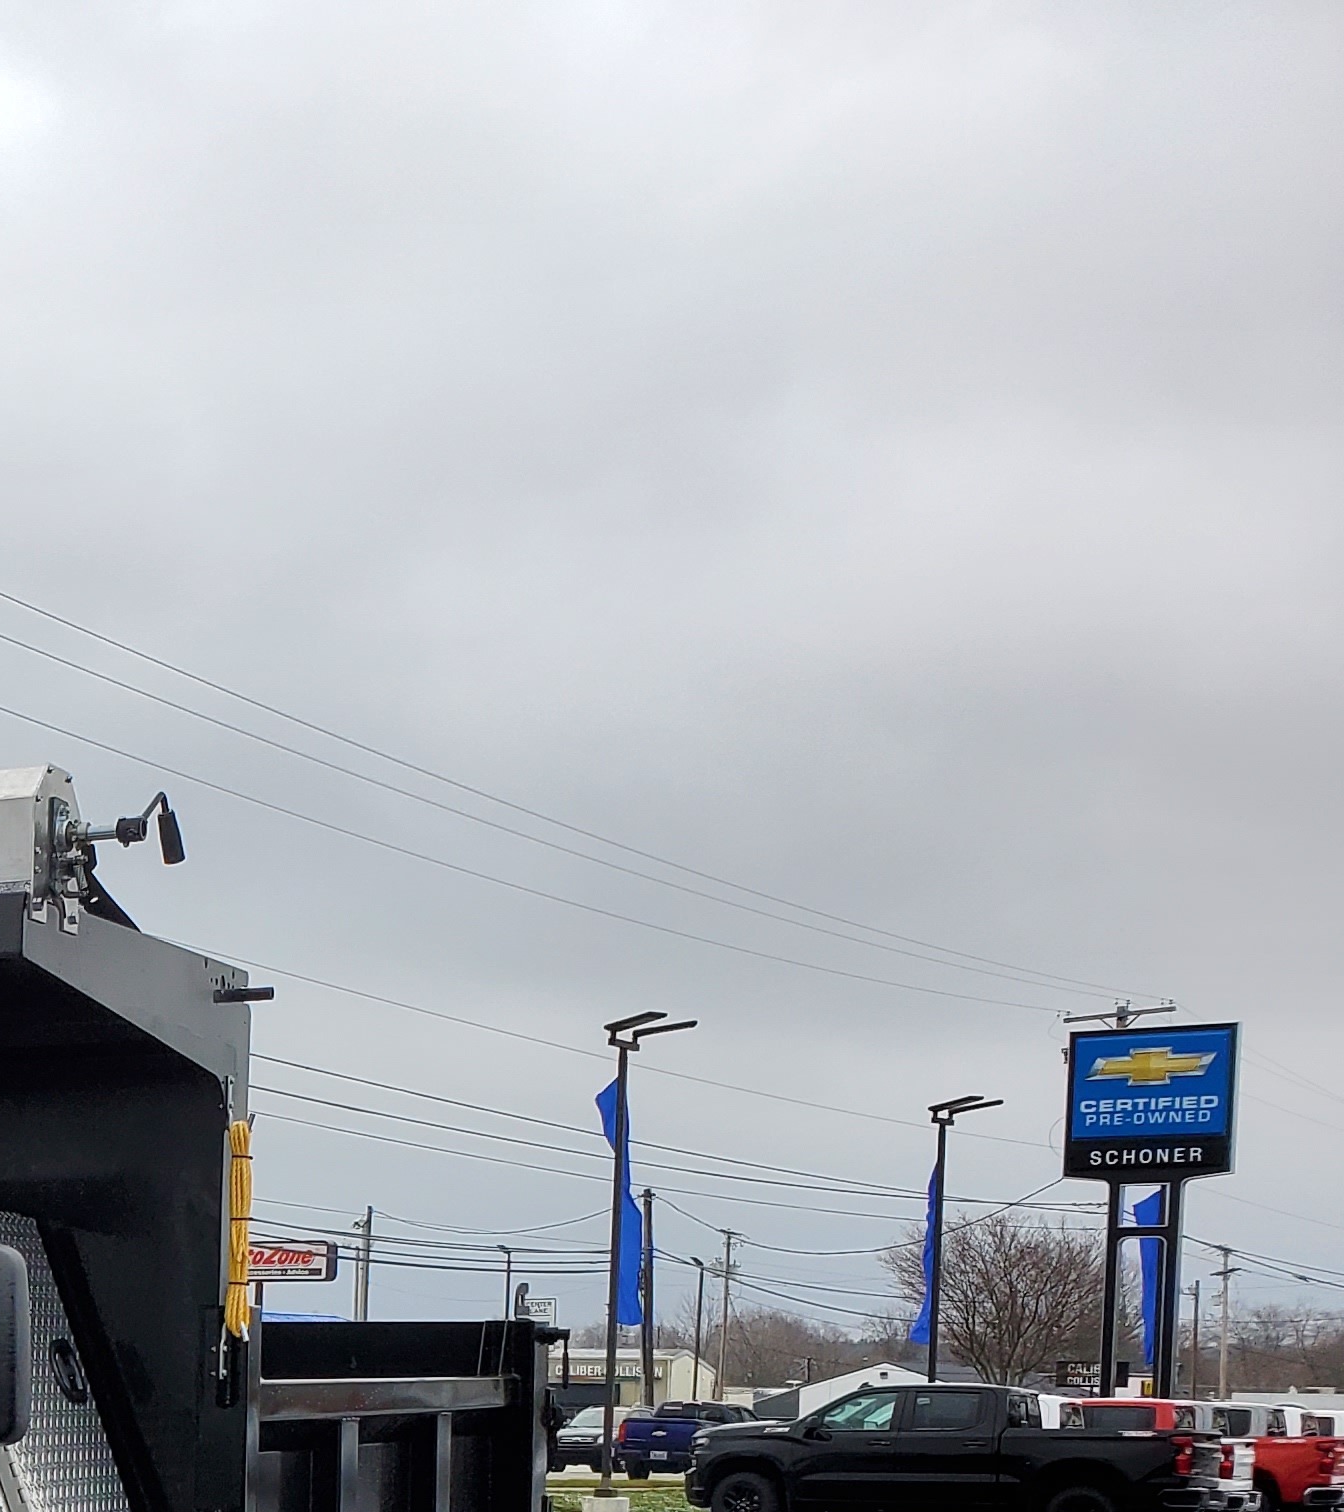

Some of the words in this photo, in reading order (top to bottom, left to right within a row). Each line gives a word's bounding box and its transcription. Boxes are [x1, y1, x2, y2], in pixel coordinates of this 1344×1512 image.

[1080, 1095, 1219, 1113] CERTIFIED
[1085, 1110, 1211, 1127] PRE-OWNED
[1089, 1147, 1203, 1166] SCHONER
[555, 1365, 603, 1376] CLIBER
[1067, 1363, 1101, 1374] CALIB
[1067, 1376, 1100, 1385] COLLIS
